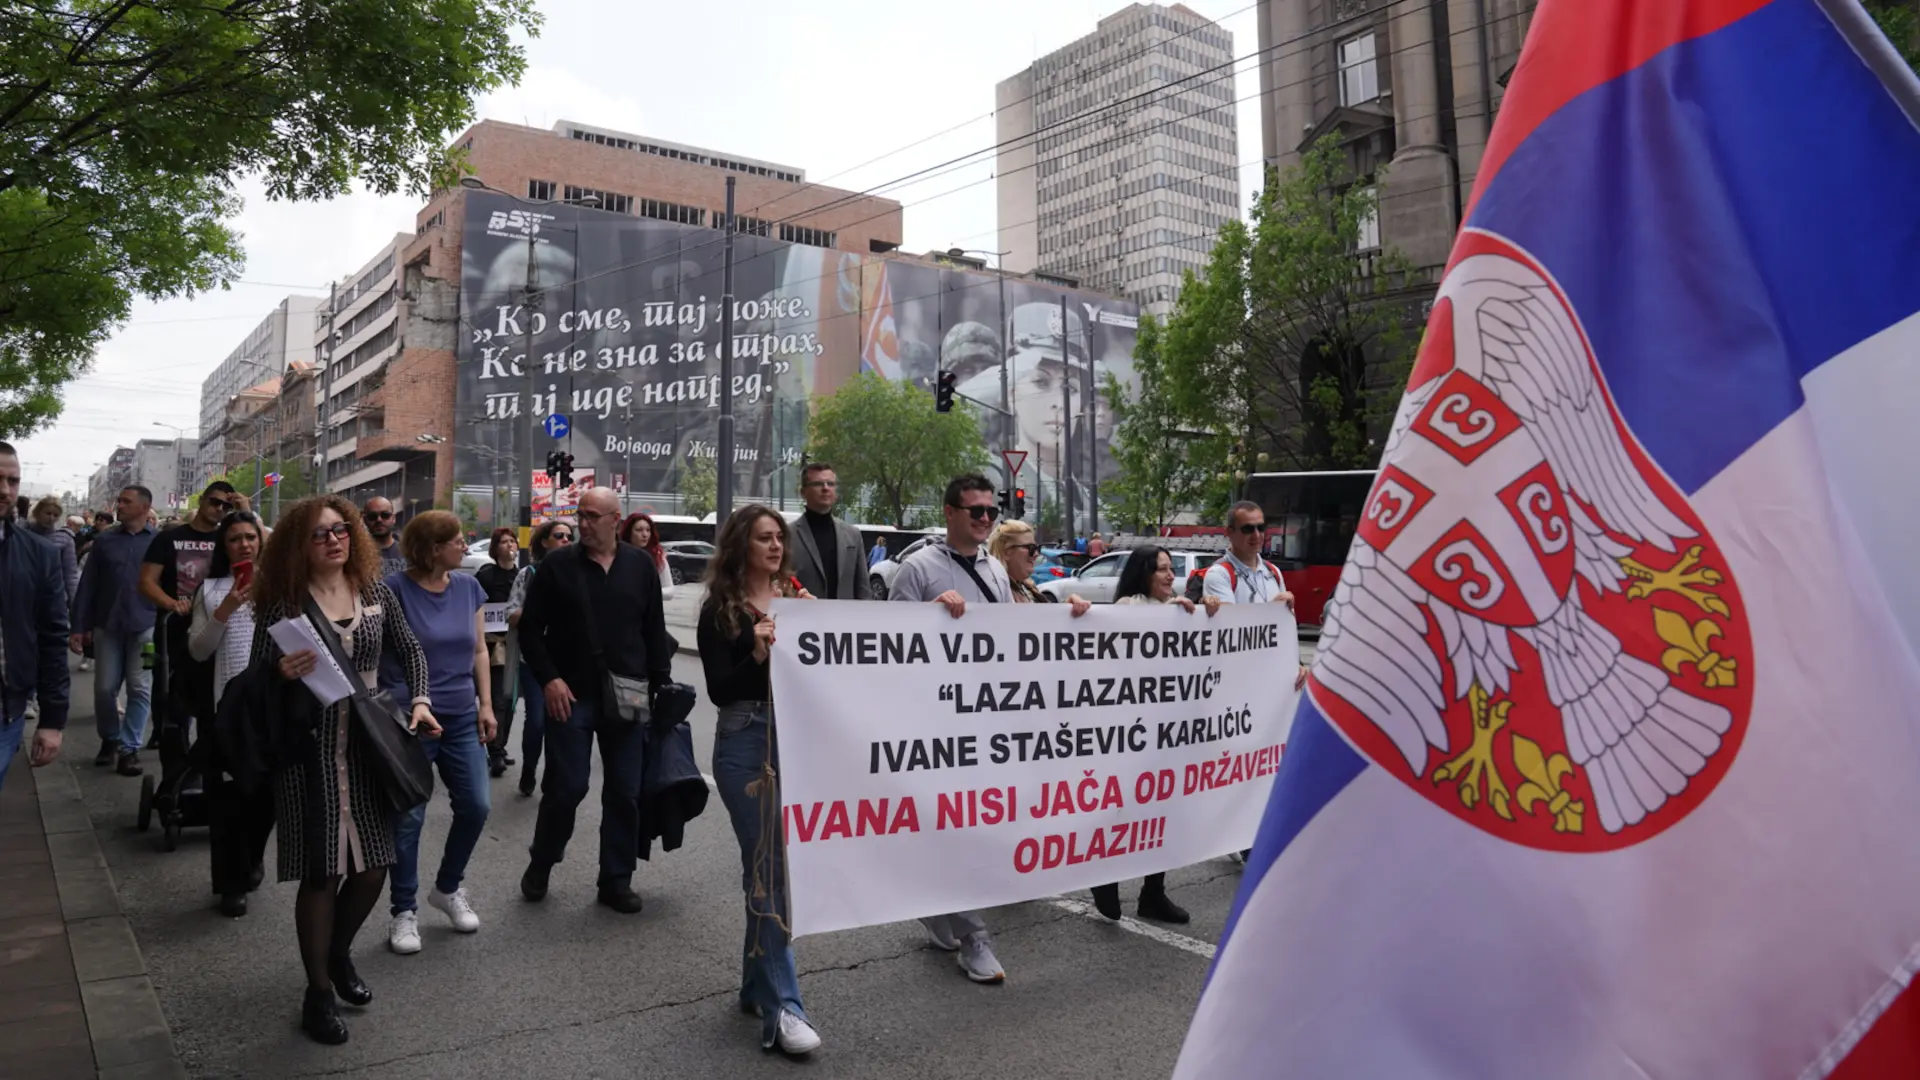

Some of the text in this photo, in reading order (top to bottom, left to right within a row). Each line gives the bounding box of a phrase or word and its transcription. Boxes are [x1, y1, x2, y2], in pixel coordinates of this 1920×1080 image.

[558, 307, 632, 334] сме,
[542, 349, 588, 376] не
[596, 344, 660, 371] зна
[668, 341, 707, 364] за
[571, 384, 633, 420] иде
[604, 434, 672, 461] Војвода
[173, 540, 215, 551] WELCO
[798, 624, 1279, 666] SMENA V.D. DIREKTORKE KLINIKE
[938, 667, 1222, 714] “LAZA LAZAREVIĆ”
[869, 703, 1253, 774] IVANE STAŠEVIĆ KARLIČIĆ
[782, 796, 921, 846] IVANA
[936, 785, 1017, 831] NISI
[1029, 769, 1125, 820] JAČA
[1135, 768, 1177, 805] OD
[1012, 816, 1167, 874] ODLAZI!!!
